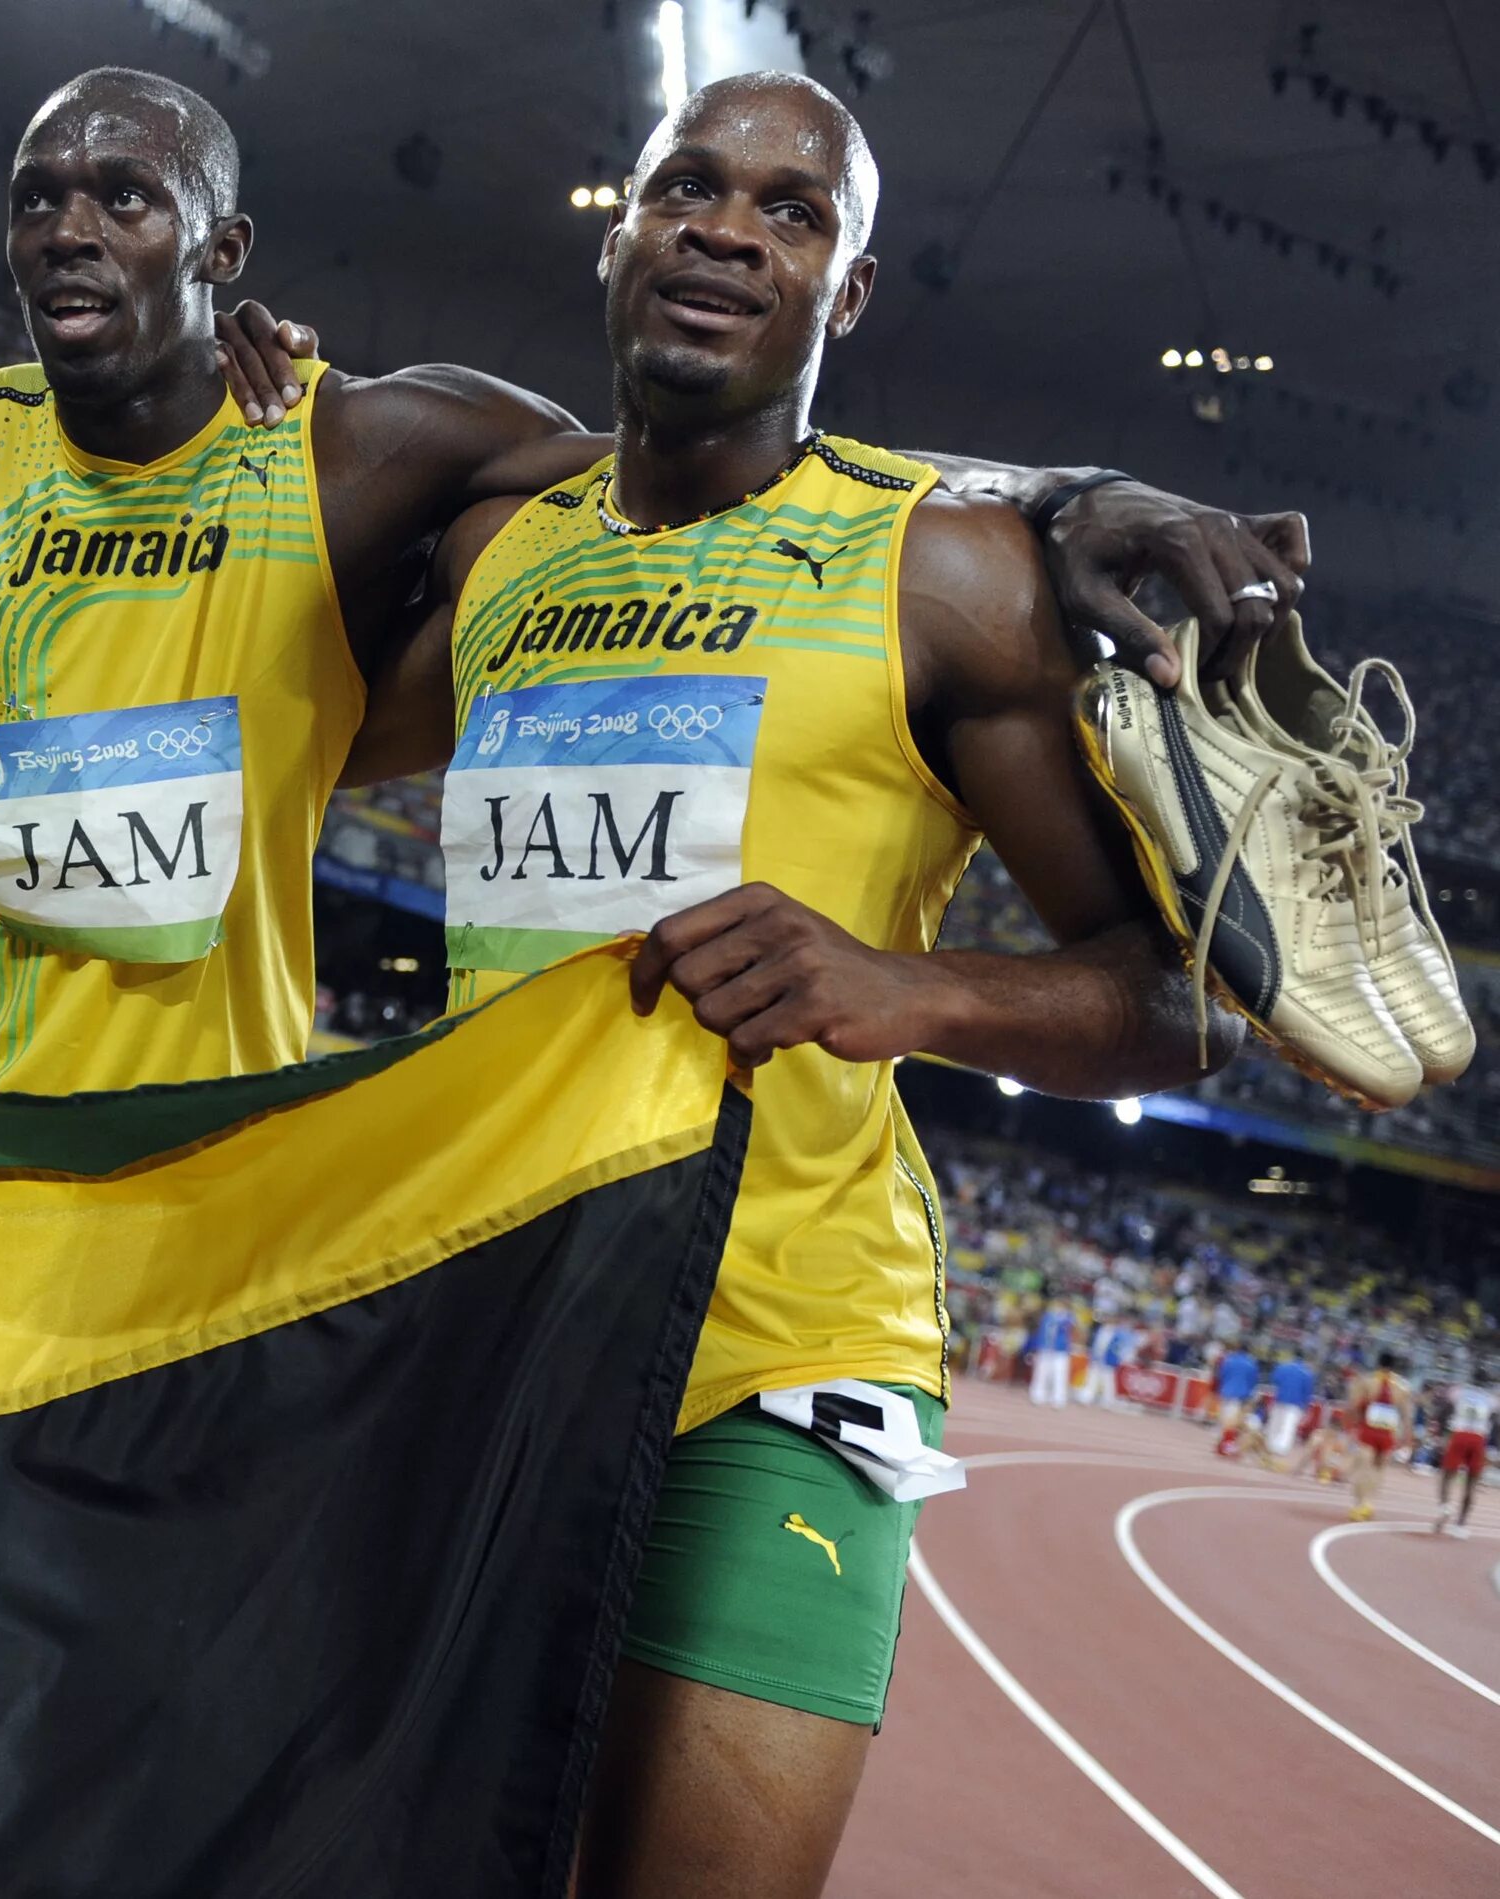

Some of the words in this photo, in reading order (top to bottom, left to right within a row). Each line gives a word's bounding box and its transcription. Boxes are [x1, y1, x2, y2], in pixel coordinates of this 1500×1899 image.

[486, 582, 759, 673] jamaica
[515, 711, 582, 743] Beijing
[584, 711, 639, 735] 2008
[1117, 695, 1132, 730] Beijing
[9, 746, 84, 773] Beijing
[86, 739, 140, 763] 2008
[13, 801, 212, 891] JAM
[480, 790, 685, 882] JAM
